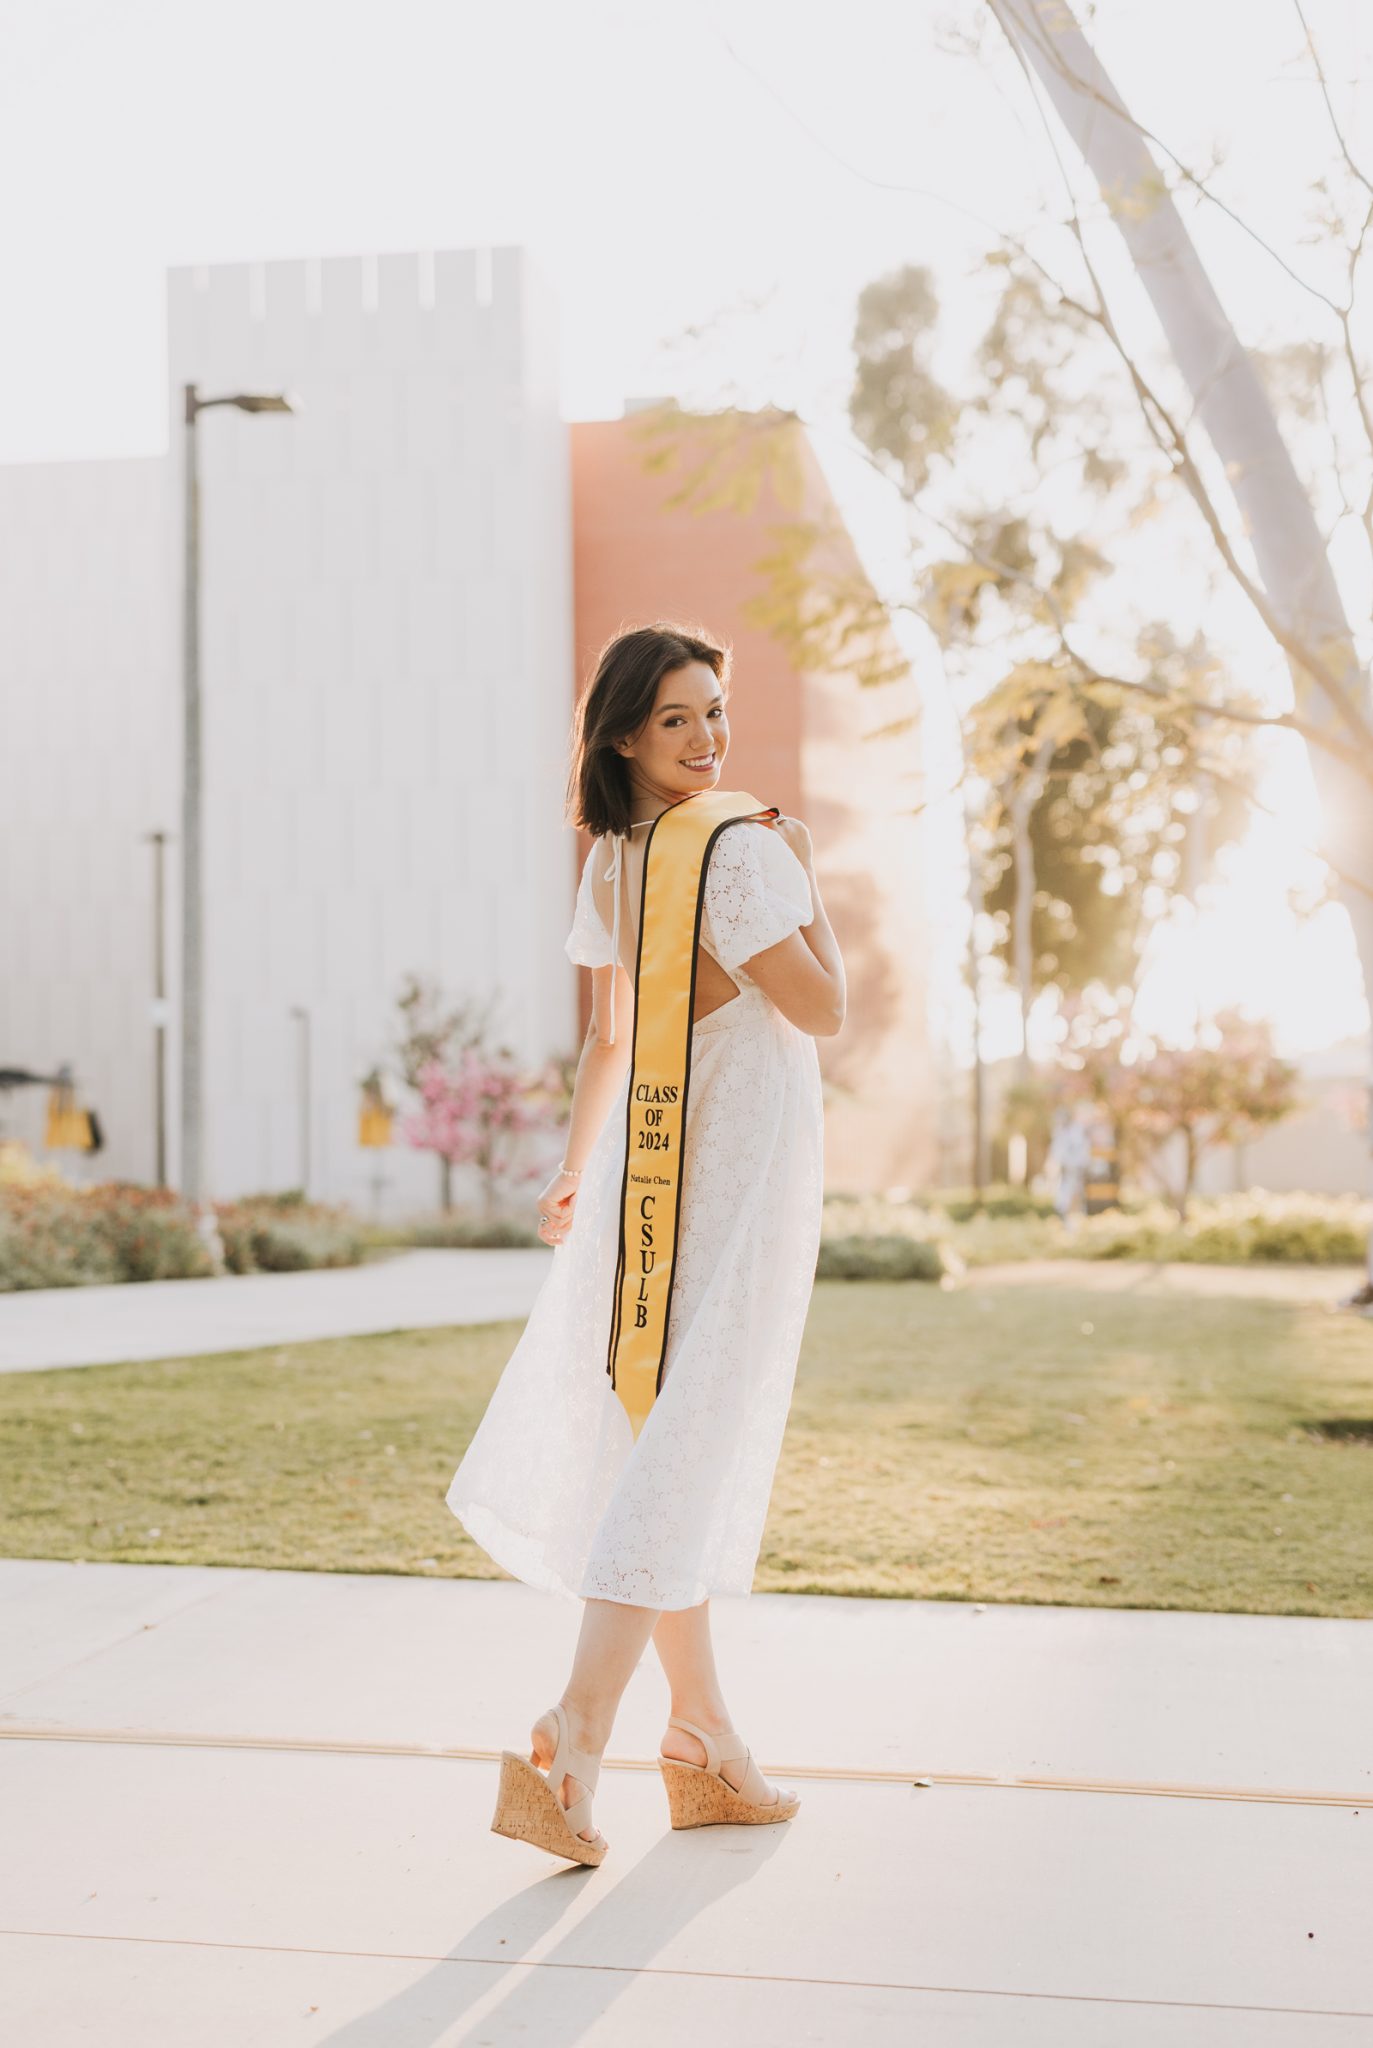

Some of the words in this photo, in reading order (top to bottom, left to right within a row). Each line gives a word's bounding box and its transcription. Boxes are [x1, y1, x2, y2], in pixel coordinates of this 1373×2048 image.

[636, 1084, 678, 1104] CLASS
[645, 1108, 664, 1127] OF
[638, 1131, 670, 1151] 2024
[630, 1174, 651, 1185] Natalie
[653, 1175, 671, 1186] Chen
[634, 1195, 656, 1328] CSULB
